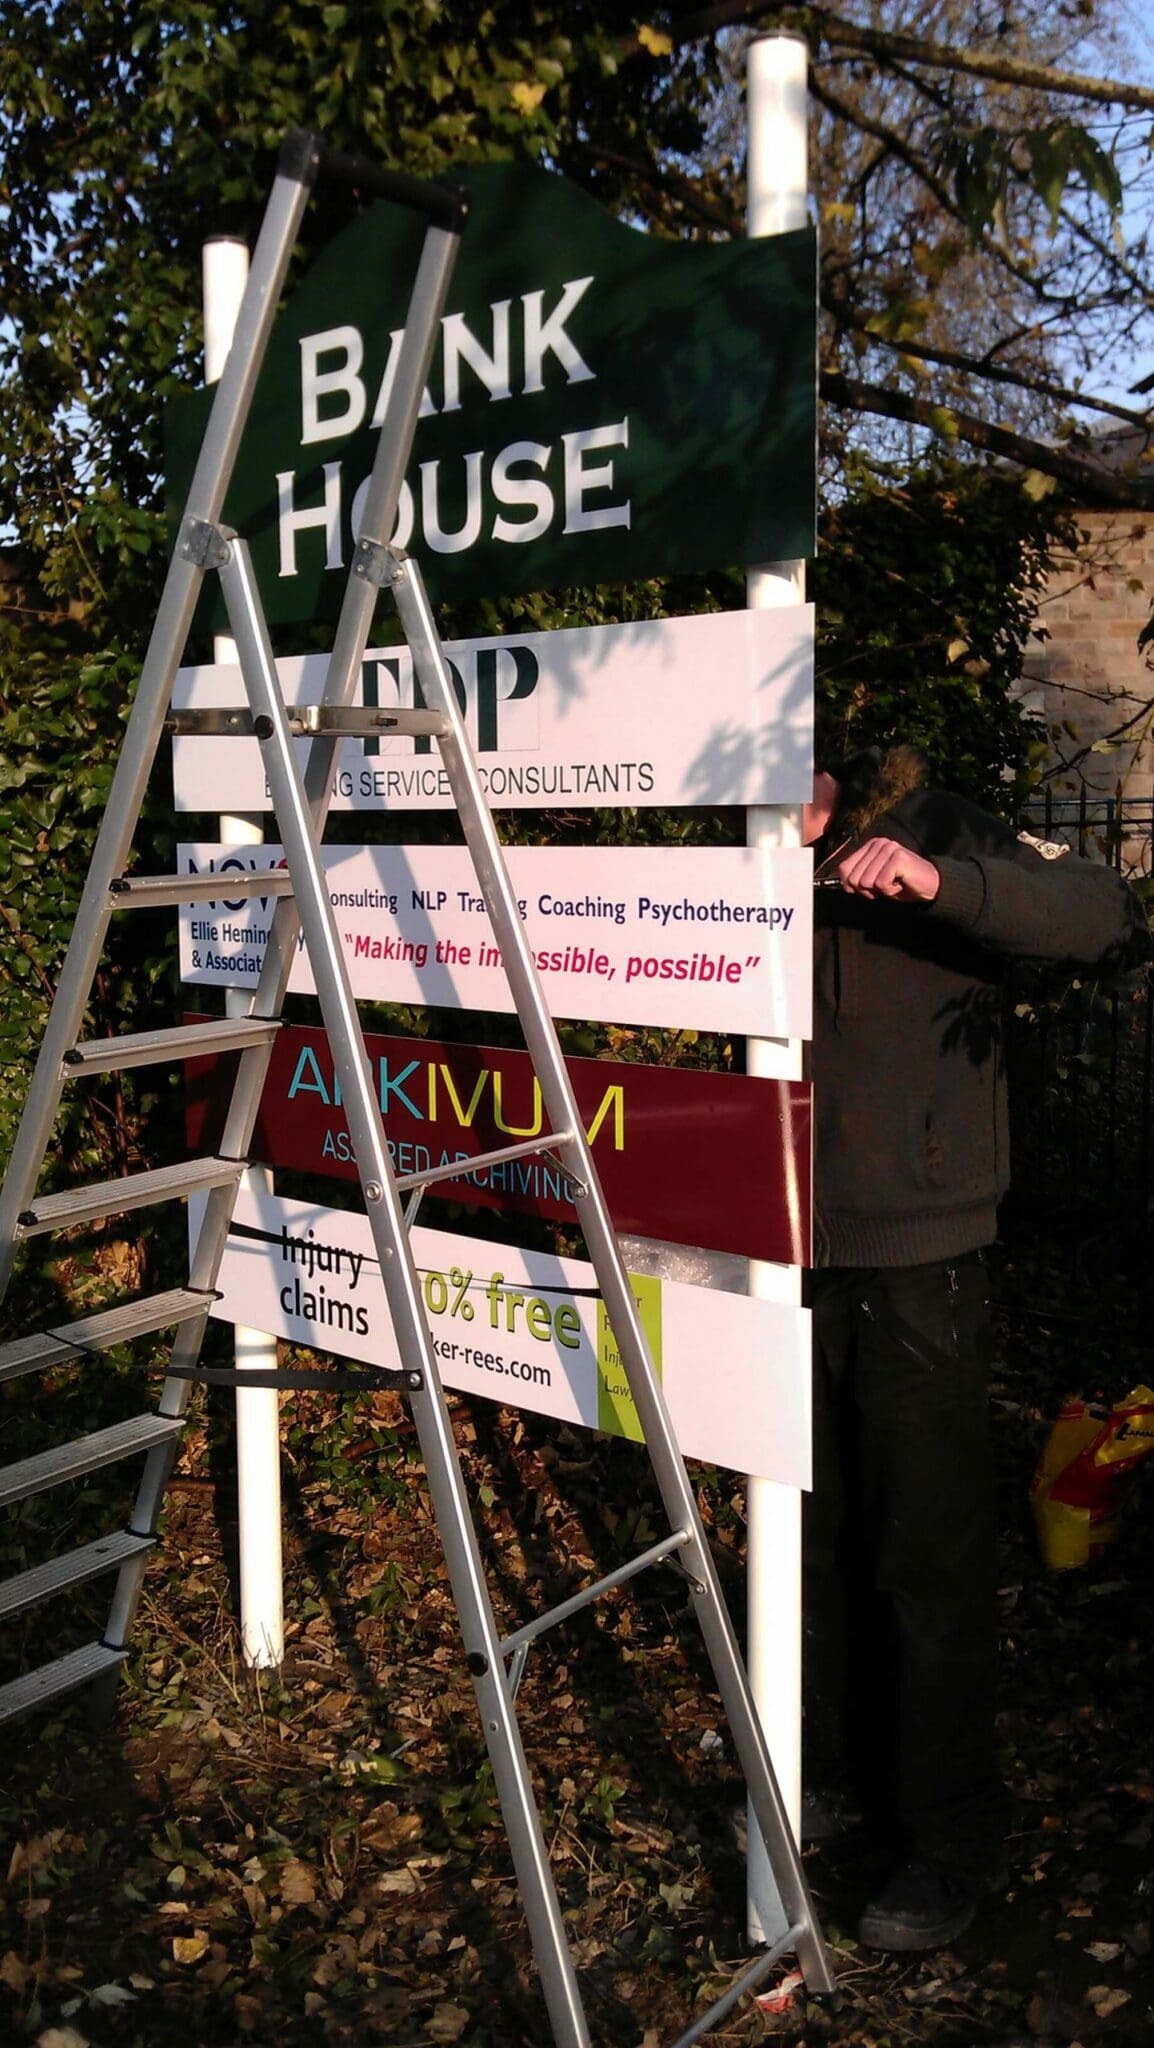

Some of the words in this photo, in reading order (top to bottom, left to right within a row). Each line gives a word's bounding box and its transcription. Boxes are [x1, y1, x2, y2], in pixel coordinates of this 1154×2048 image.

[276, 416, 631, 577] HOUSE
[360, 771, 450, 797] SERVICE
[191, 921, 218, 942] Ellie
[331, 889, 397, 914] onsulting
[411, 890, 447, 911] NLP
[457, 892, 527, 920] Trag
[538, 894, 626, 924] Coaching
[638, 897, 794, 931] Psychotherapy
[192, 950, 202, 969] &
[205, 951, 262, 973] Associat
[435, 940, 471, 966] the
[478, 942, 616, 980] imssible,
[322, 1129, 430, 1174] ASRED
[281, 1225, 364, 1290] Injury
[279, 1278, 369, 1335] claims
[486, 1271, 581, 1349] free
[430, 1331, 551, 1387] ker-rees.com
